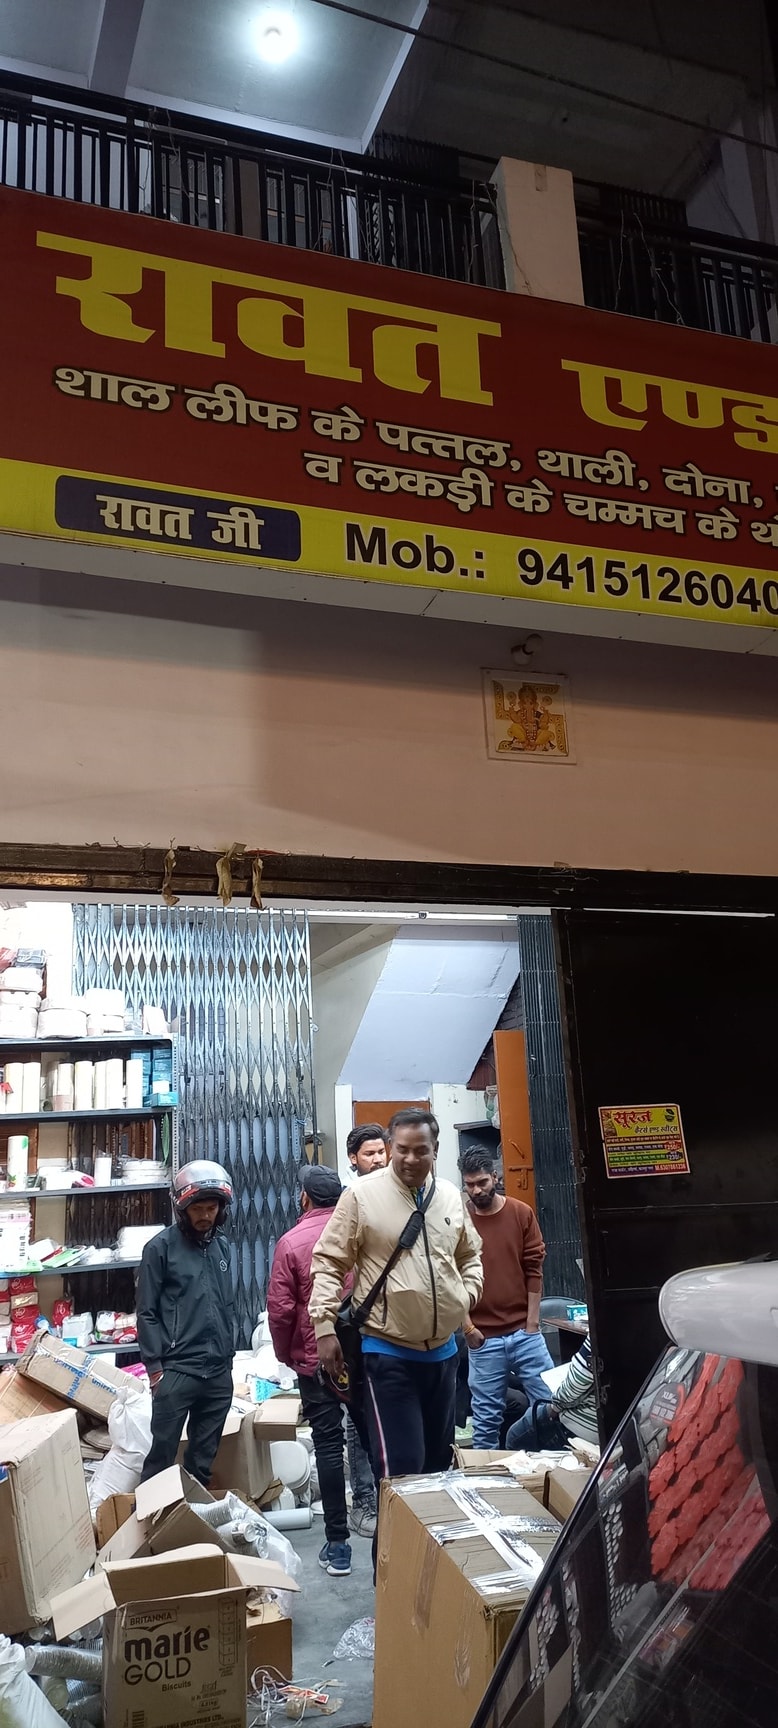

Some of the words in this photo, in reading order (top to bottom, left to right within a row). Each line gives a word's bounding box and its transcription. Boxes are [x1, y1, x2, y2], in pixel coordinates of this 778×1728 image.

[36, 231, 501, 407] रावत
[55, 367, 175, 411] शाल
[184, 383, 299, 430] लीफ
[311, 406, 365, 442] के
[376, 421, 522, 472] पत्तल,
[538, 449, 650, 492] थाली,
[662, 463, 764, 508] दोना,
[304, 451, 343, 483] व
[353, 460, 494, 513] लकड़ी
[504, 478, 554, 514] के
[563, 493, 687, 535] चम्मच
[696, 507, 740, 541] के
[96, 495, 195, 540] रावत
[207, 507, 265, 550] जी
[345, 522, 485, 580] Mob.:
[517, 547, 778, 616] 9415126040
[613, 1110, 652, 1129] सूरज
[130, 1612, 172, 1626] BRITANNIA
[124, 1626, 209, 1663] marie
[124, 1657, 191, 1686] GOLD
[161, 1680, 192, 1692] Biscuits
